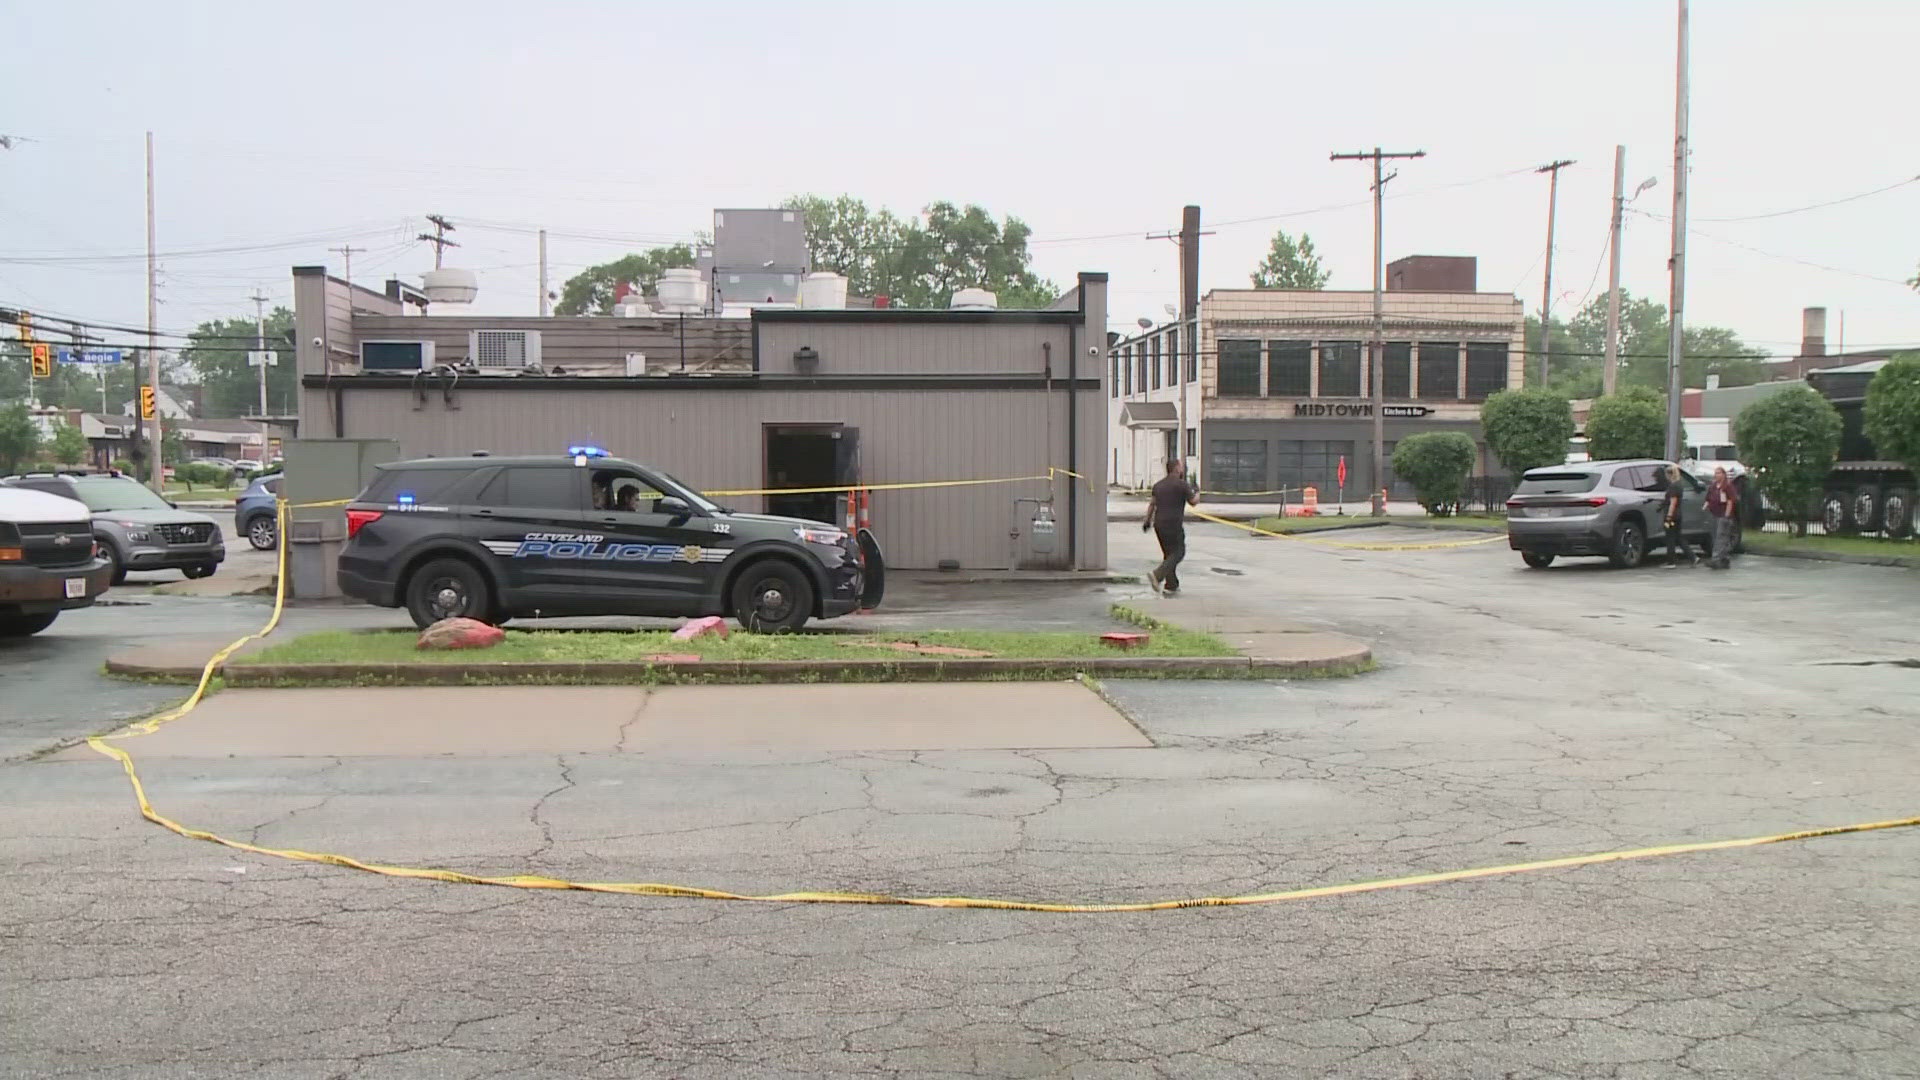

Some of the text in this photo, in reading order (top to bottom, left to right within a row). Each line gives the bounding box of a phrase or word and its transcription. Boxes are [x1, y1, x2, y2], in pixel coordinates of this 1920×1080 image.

[1294, 404, 1423, 416] MIDTOWN Kitchen & Bar
[713, 523, 730, 534] 332
[524, 532, 604, 543] CLEVELAND
[514, 541, 681, 562] POLICE
